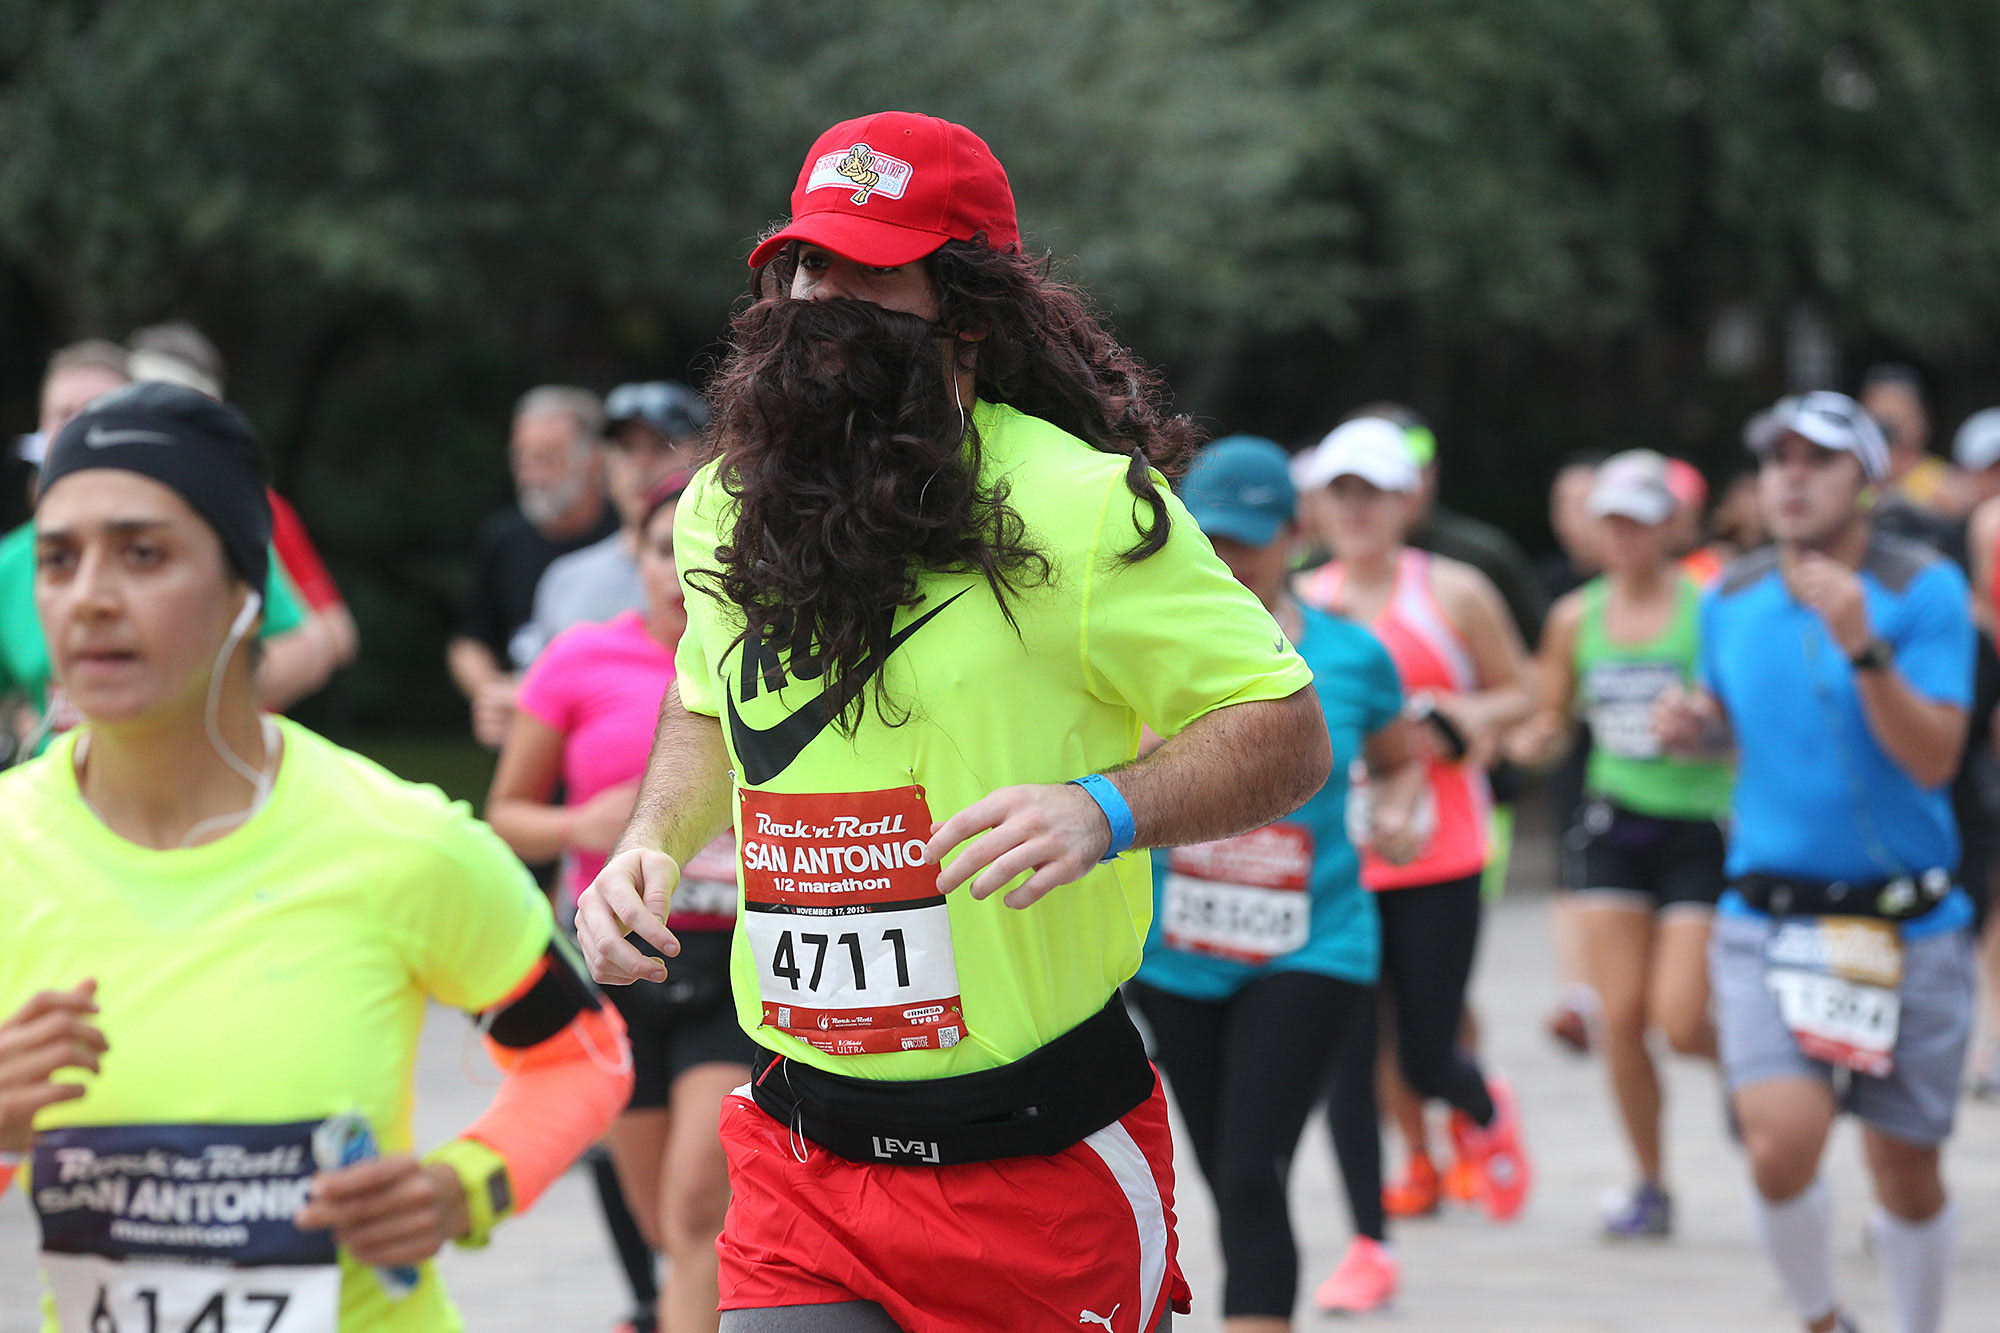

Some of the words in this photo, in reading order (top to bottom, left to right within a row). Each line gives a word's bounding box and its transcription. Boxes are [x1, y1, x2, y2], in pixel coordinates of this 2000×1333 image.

[755, 812, 813, 838] Rock
[833, 814, 907, 837] Roll
[744, 841, 788, 873] SAN
[792, 838, 927, 875] ANTONIO
[773, 877, 795, 892] 1/2
[799, 877, 891, 893] marathon
[796, 907, 834, 916] NOVEMBER
[835, 907, 845, 916] 17,
[846, 905, 866, 915] 2013
[772, 928, 910, 992] 4711
[836, 1046, 866, 1054] ULTRA
[872, 1136, 940, 1163] LEVEL
[38, 1177, 129, 1215] SAN
